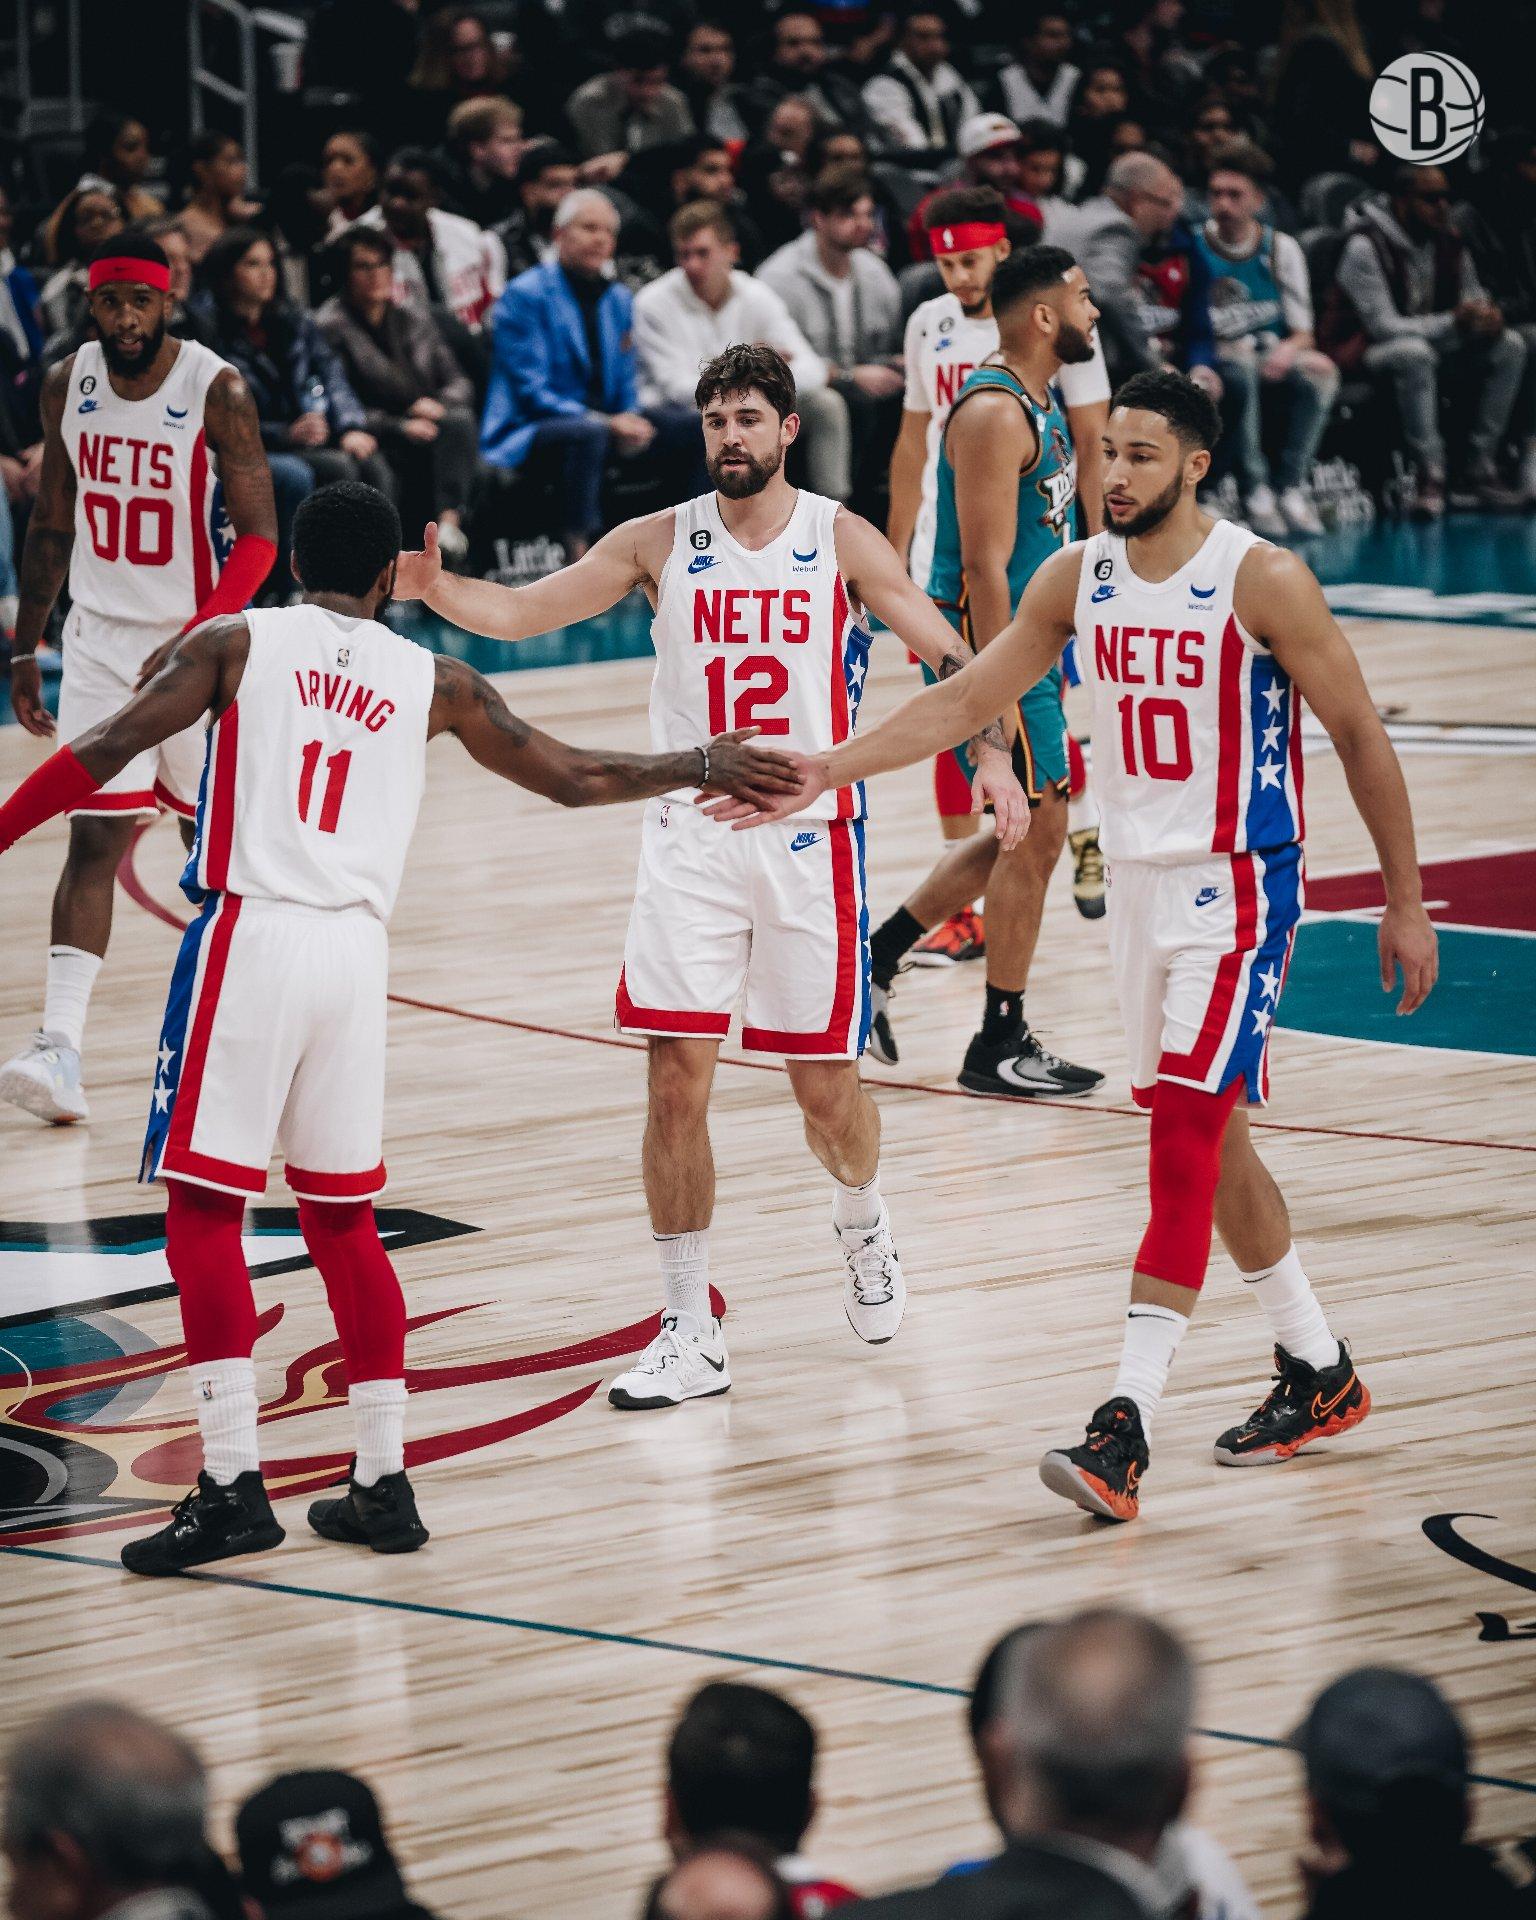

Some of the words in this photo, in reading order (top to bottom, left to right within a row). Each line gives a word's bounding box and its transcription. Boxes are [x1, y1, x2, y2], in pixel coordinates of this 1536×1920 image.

[937, 363, 973, 406] NE
[78, 431, 175, 490] NETS
[84, 491, 174, 566] 00
[792, 565, 818, 573] Webull
[693, 588, 811, 644] NETS
[1095, 624, 1205, 688] NETS
[294, 670, 395, 733] IRVING
[704, 655, 790, 737] 12
[1117, 694, 1194, 782] 10
[298, 739, 353, 834] 11
